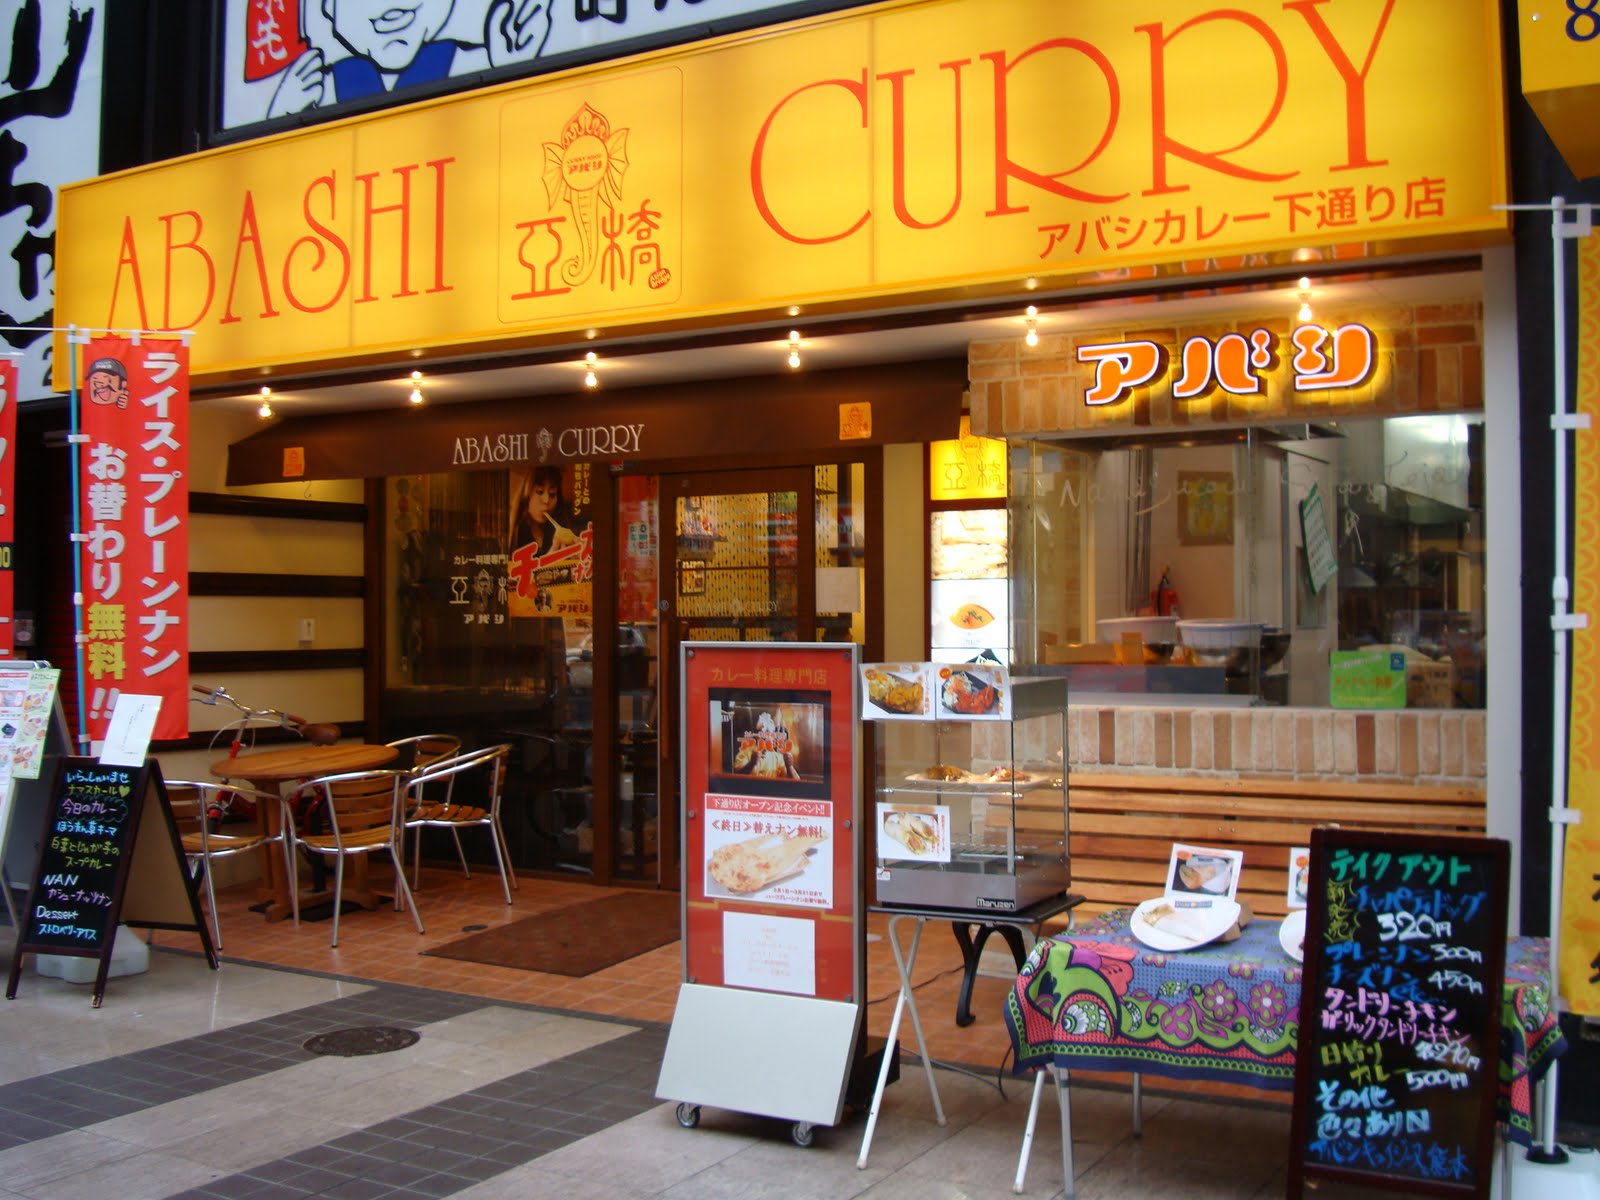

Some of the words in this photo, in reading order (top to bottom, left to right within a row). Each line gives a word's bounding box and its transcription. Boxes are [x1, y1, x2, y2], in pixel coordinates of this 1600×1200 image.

[104, 157, 455, 339] ABASHI
[751, 0, 1396, 246] CURRY
[1037, 176, 1447, 261] アバシカレー下通り店
[1076, 324, 1373, 407] アバシ
[452, 434, 529, 465] ABASHI
[558, 423, 645, 457] CURRY
[453, 555, 509, 565] カレー料理専門
[62, 798, 118, 815] 今日のカレー
[43, 873, 79, 886] NAN
[36, 905, 79, 920] Dessert
[977, 897, 1015, 909] Maruzen
[1428, 970, 1483, 995] 450円
